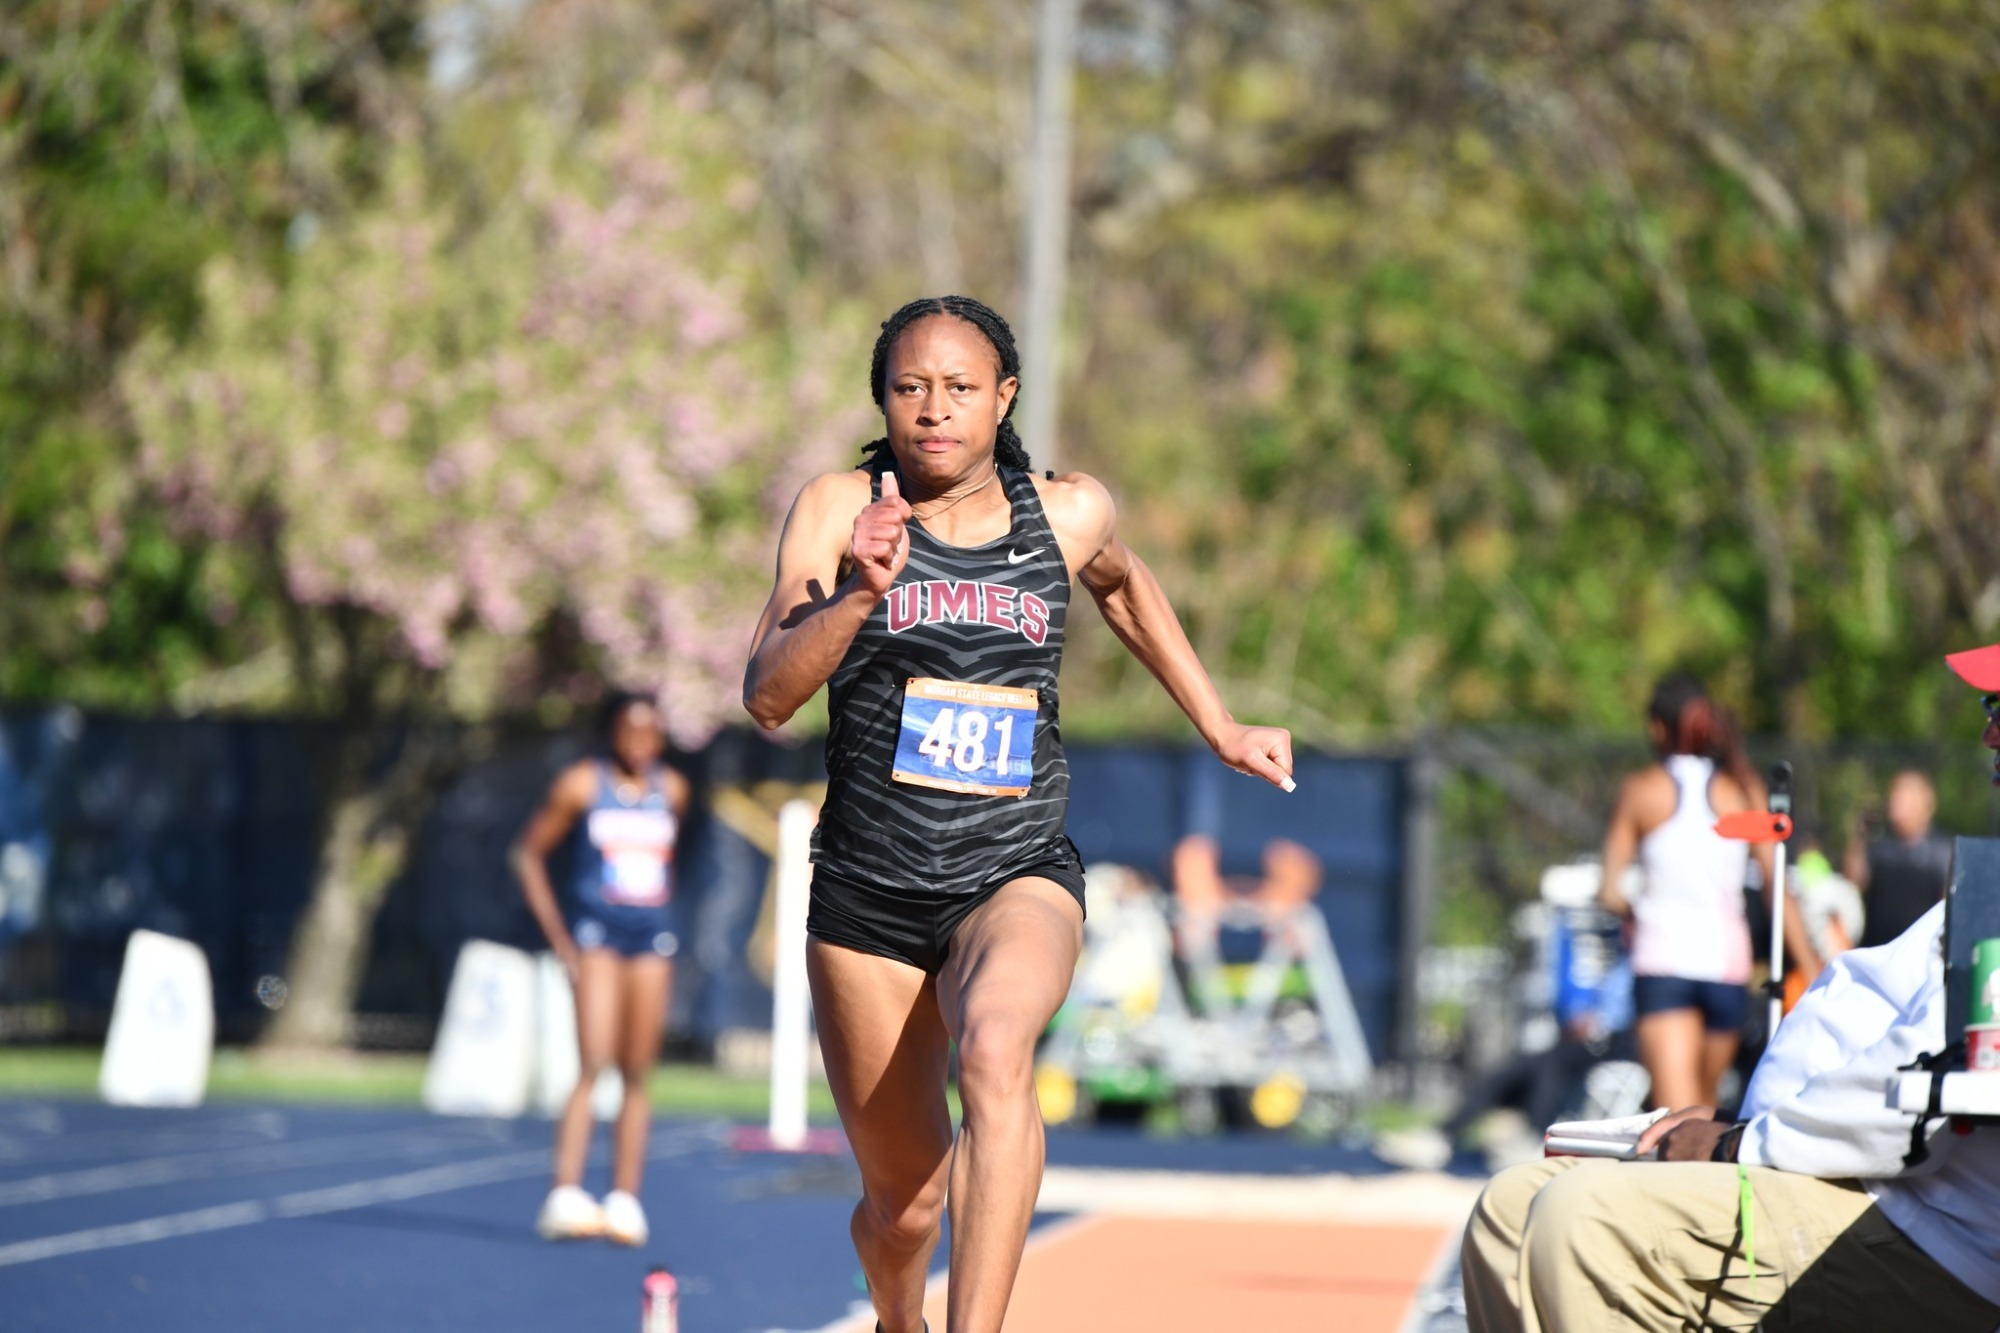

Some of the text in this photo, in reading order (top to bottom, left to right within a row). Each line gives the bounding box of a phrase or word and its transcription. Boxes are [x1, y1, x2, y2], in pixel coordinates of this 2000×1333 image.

[885, 580, 1049, 647] UMES
[957, 688, 979, 700] STATE
[982, 691, 1005, 702] LEGACY
[919, 708, 1013, 776] 481
